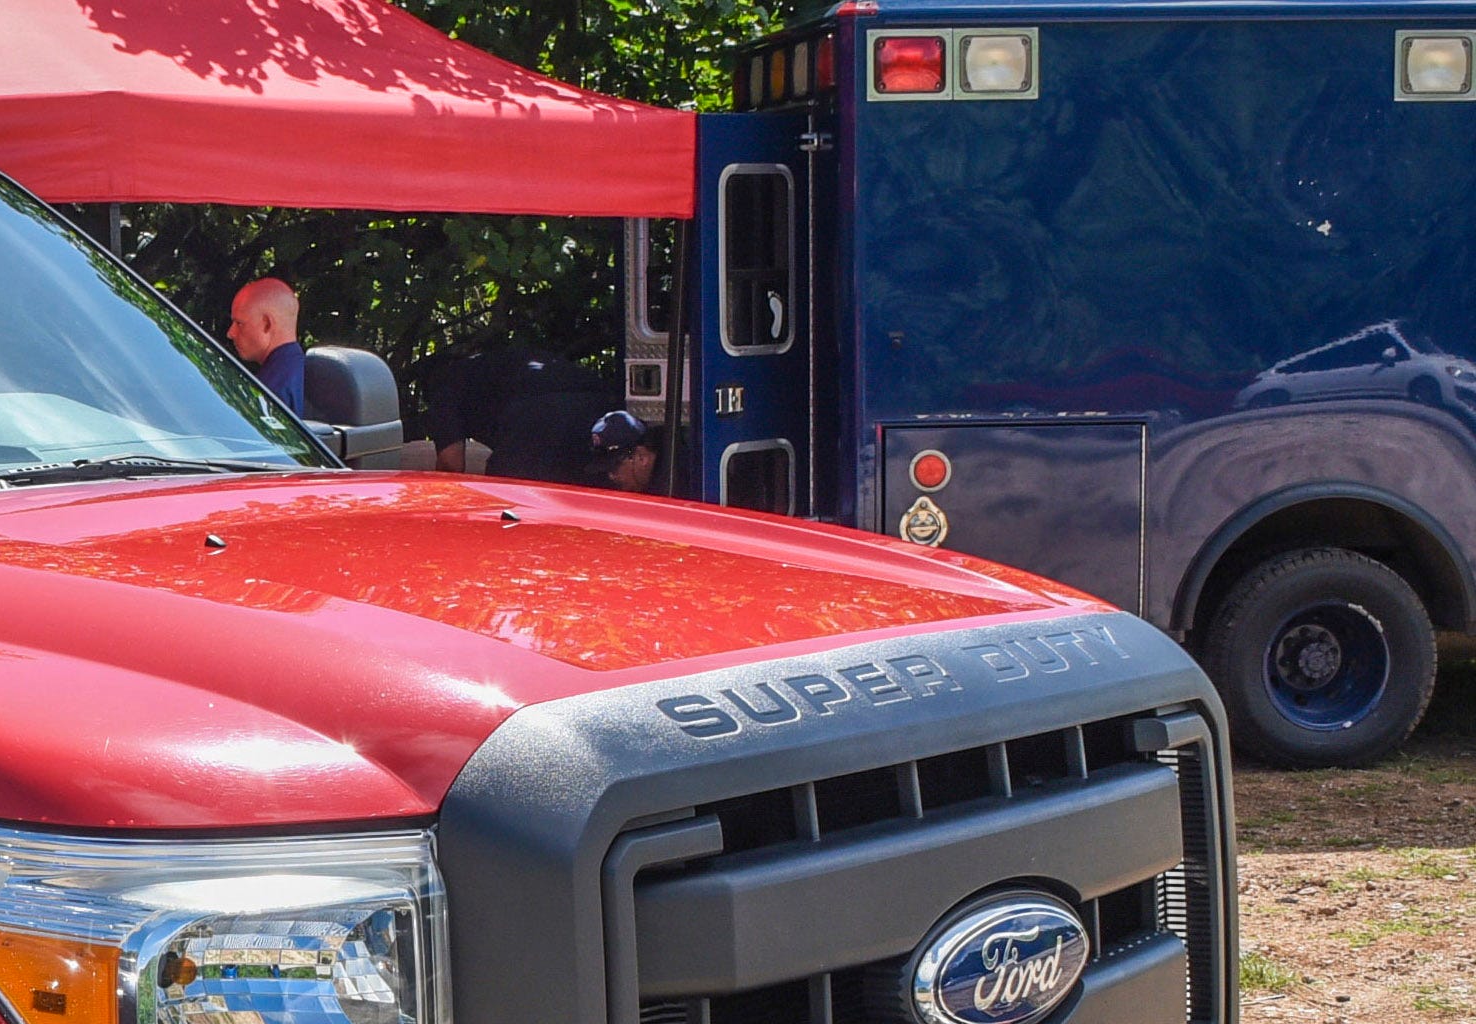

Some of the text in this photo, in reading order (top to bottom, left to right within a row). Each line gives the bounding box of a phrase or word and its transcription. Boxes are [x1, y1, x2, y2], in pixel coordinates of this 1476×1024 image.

[656, 624, 1131, 741] SUPER DUTY
[974, 926, 1063, 1011] Ford
